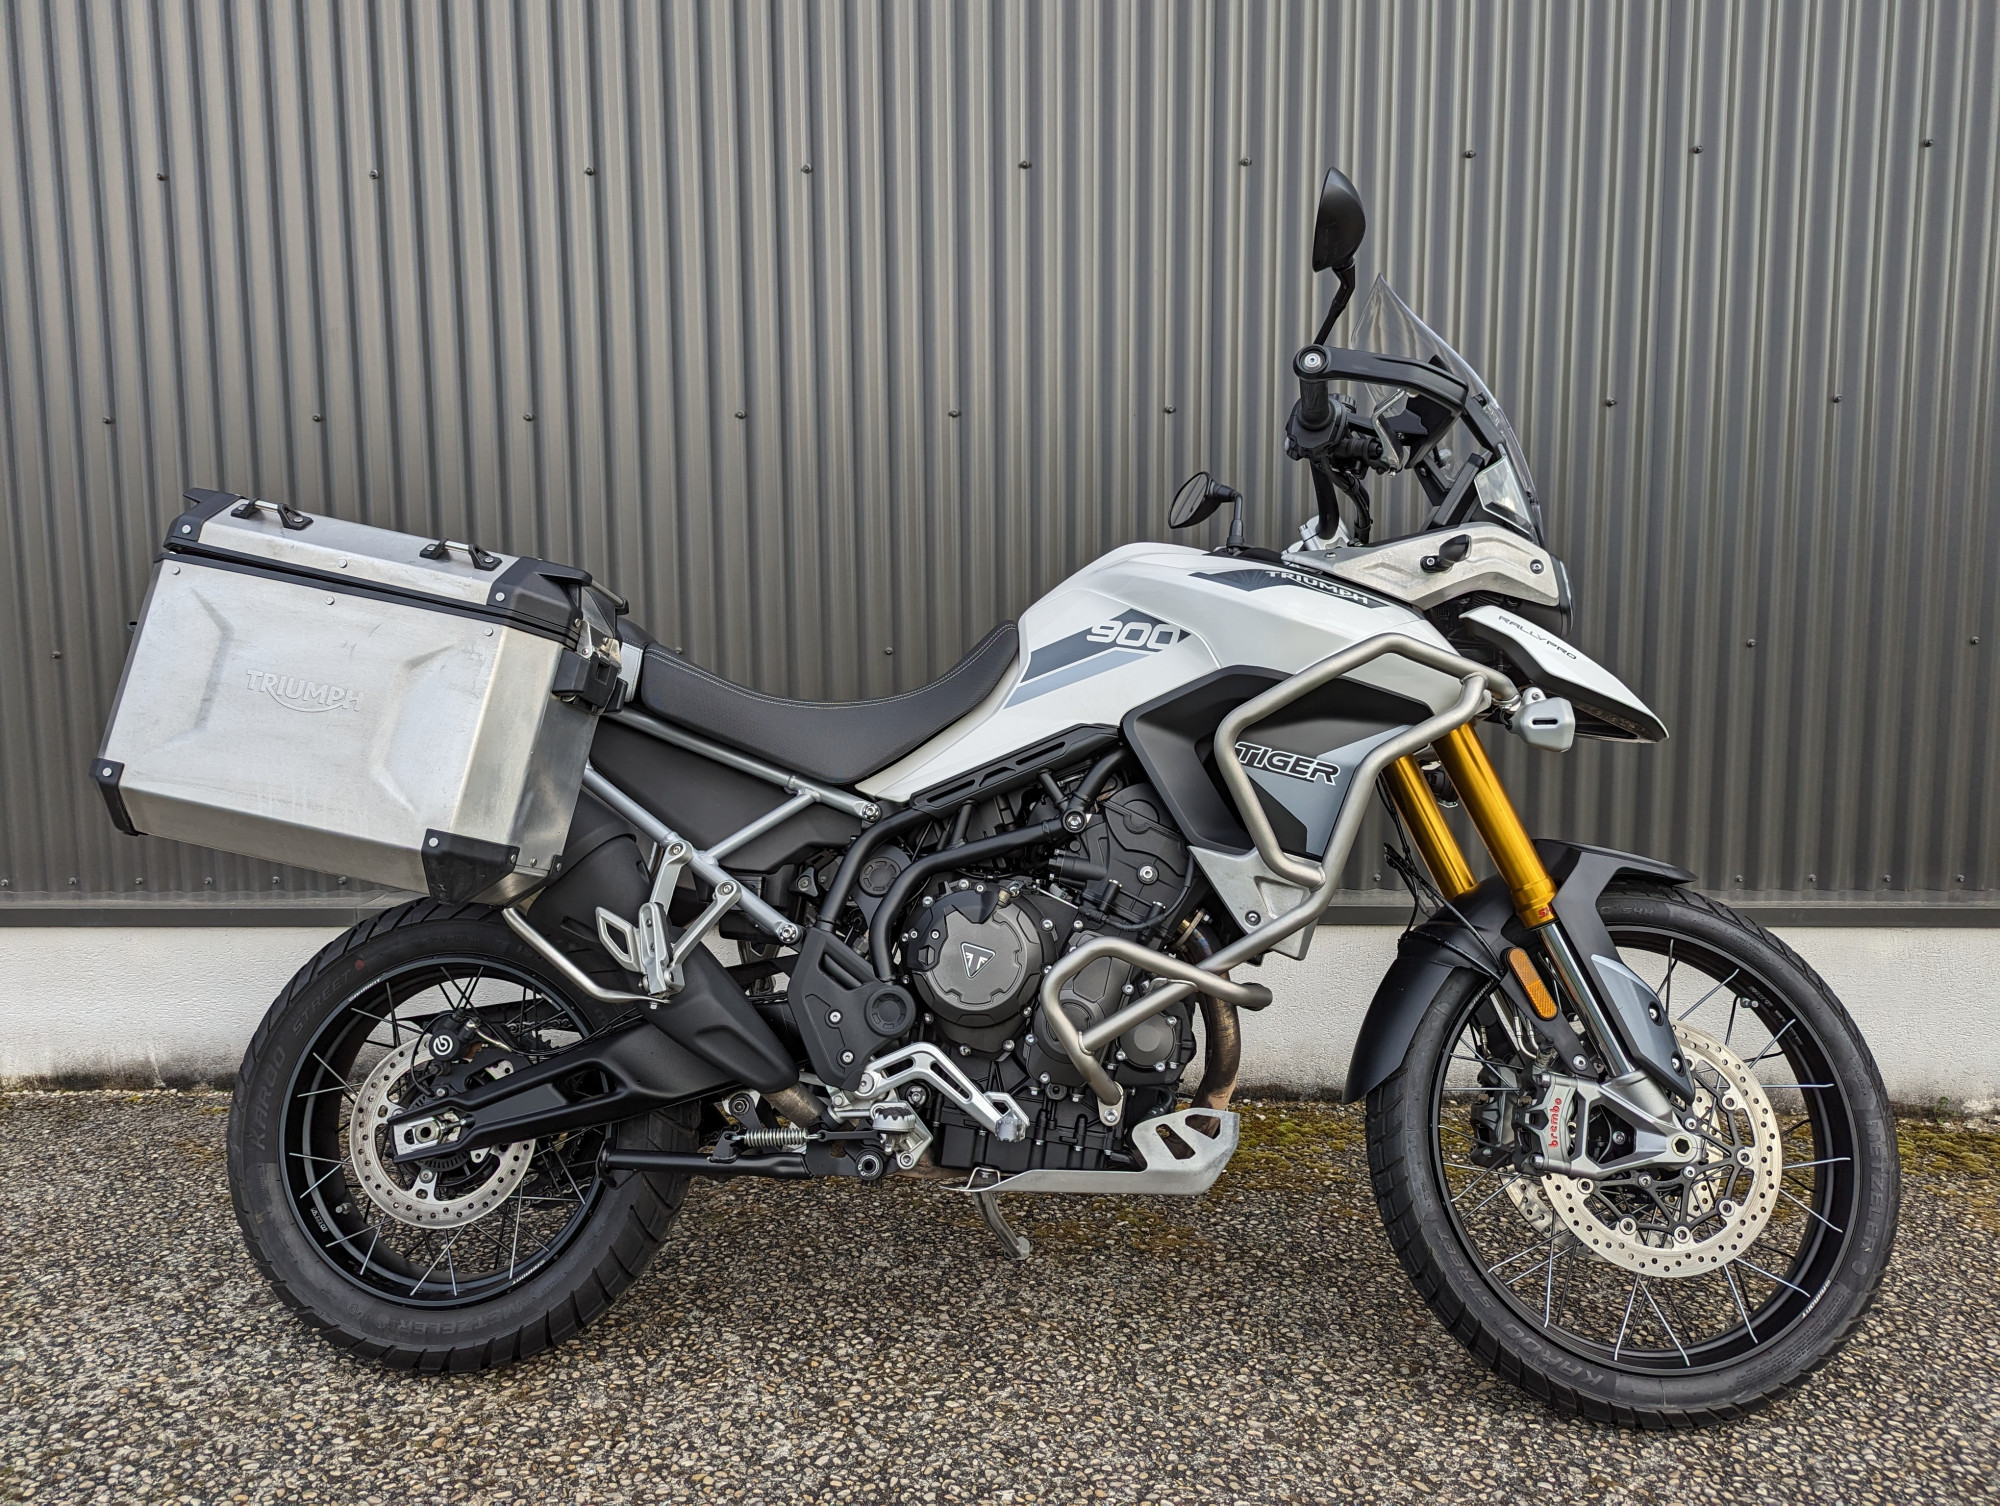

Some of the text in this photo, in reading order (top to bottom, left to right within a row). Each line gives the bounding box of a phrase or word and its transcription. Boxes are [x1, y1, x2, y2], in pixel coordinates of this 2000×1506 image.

[1265, 570, 1369, 605] TRIUMPH
[1086, 620, 1181, 651] 900
[246, 669, 363, 713] TRIUMPH
[1235, 741, 1341, 786] TIGER
[293, 970, 352, 1037] STREET
[1548, 1097, 1563, 1148] brembo
[1861, 1120, 1886, 1252] METZELER
[1435, 1228, 1496, 1309] STREET
[399, 1301, 524, 1336] METZELER
